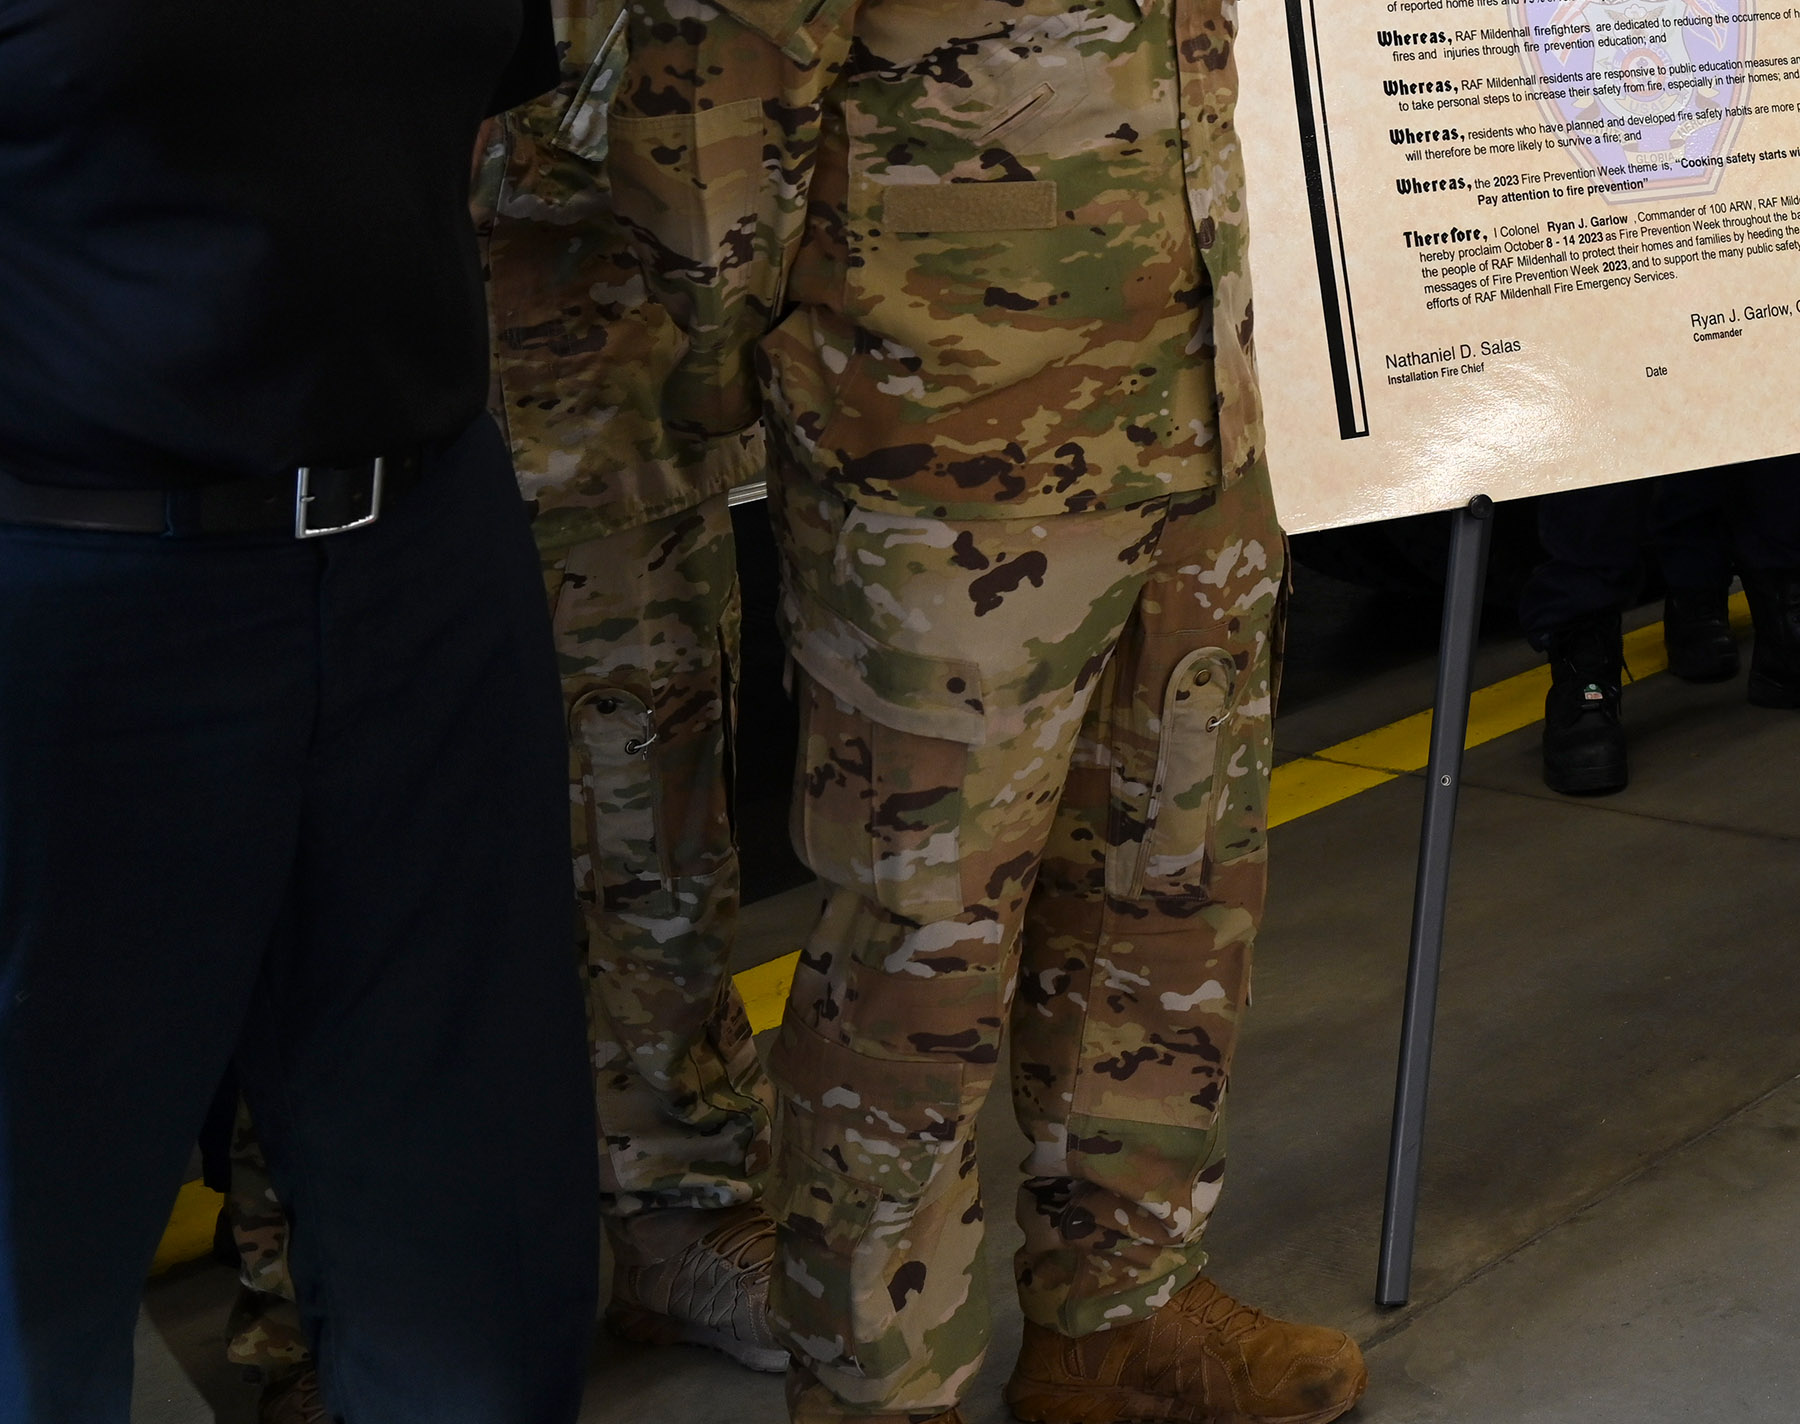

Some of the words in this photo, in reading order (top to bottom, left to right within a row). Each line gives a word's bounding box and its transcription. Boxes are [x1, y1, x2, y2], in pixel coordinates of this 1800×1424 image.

[1386, 0, 1399, 14] of
[1391, 49, 1417, 63] fires
[1416, 47, 1439, 62] and
[1442, 45, 1481, 62] injuries
[1480, 41, 1522, 58] through
[1522, 40, 1541, 54] fire
[1542, 37, 1596, 55] prevention
[1596, 33, 1648, 49] education;
[1648, 31, 1668, 45] and
[1629, 97, 1668, 113] USAF
[1635, 152, 1675, 165] GLORIA
[1476, 193, 1499, 208] Pay
[1500, 187, 1552, 205] attention
[1551, 186, 1565, 199] to
[1565, 183, 1586, 197] fire
[1425, 295, 1461, 311] efforts
[1460, 292, 1473, 307] of
[1473, 289, 1498, 305] RAF
[1499, 283, 1553, 302] Mildenhall
[1552, 281, 1575, 295] Fire
[1574, 275, 1633, 292] Emergency
[1632, 269, 1679, 285] Services.
[1689, 312, 1727, 331] Ryan
[1727, 307, 1742, 324] J.
[1742, 302, 1794, 322] Garlow,
[1692, 326, 1744, 344] Commander
[1384, 344, 1457, 371] Nathaniel
[1458, 342, 1477, 360] D.
[1479, 338, 1523, 357] Salas
[1386, 368, 1440, 386] Installation
[1439, 365, 1460, 379] Fire
[1459, 360, 1486, 376] Chief
[1644, 364, 1669, 379] Date
